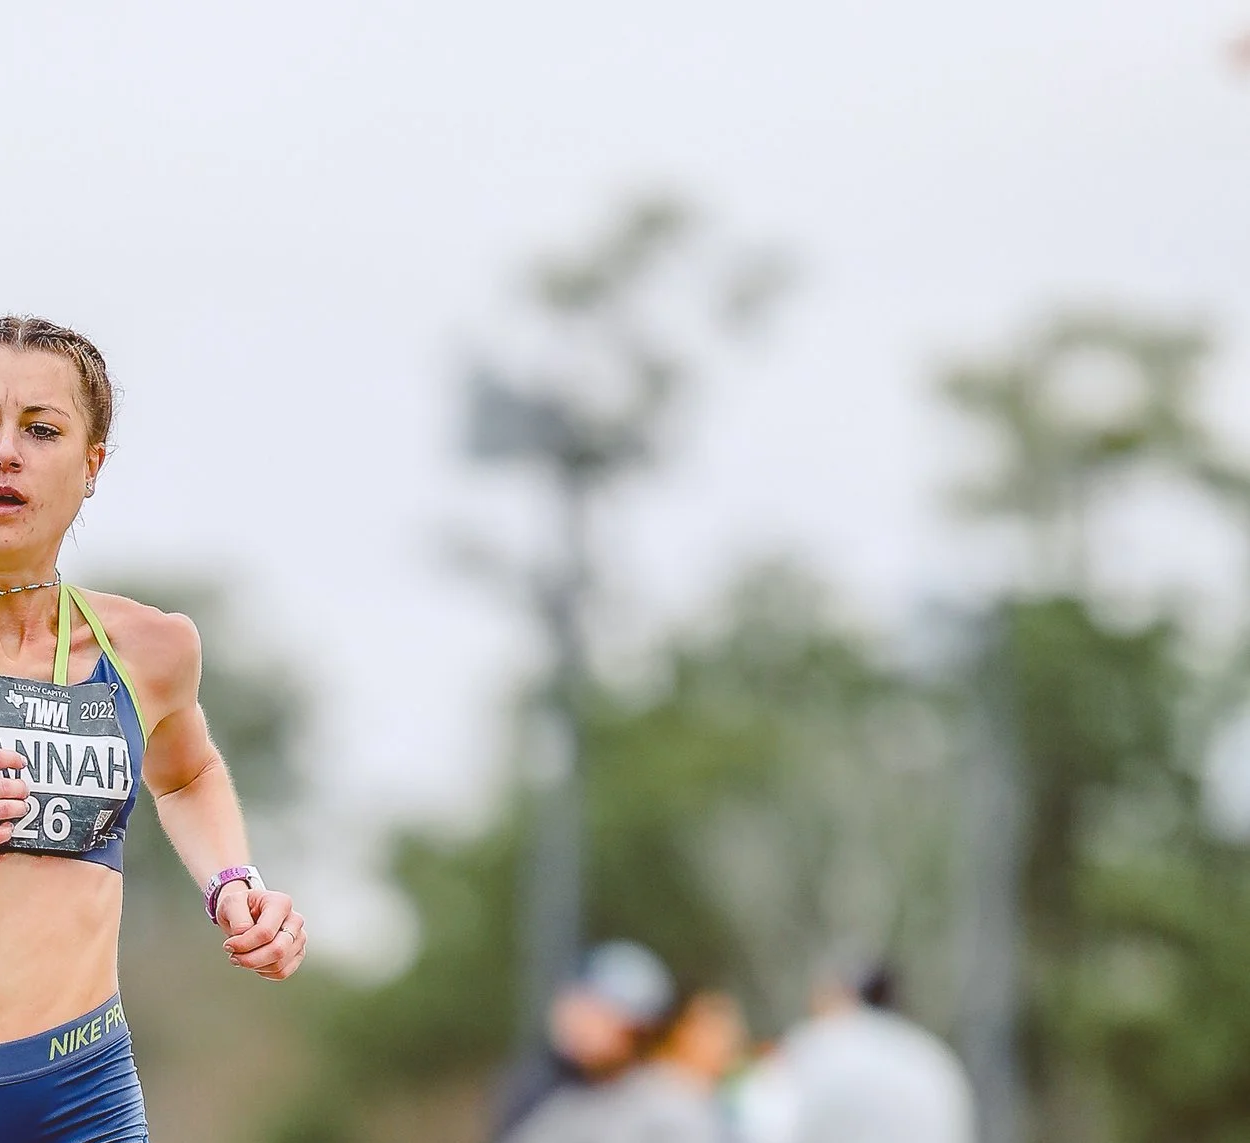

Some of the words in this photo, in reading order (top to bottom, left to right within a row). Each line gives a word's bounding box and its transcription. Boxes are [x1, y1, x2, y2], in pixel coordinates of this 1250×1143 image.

[13, 683, 41, 693] LEGACY
[42, 687, 71, 698] CAPITAL
[24, 696, 69, 728] TWM
[80, 701, 115, 720] 2022
[12, 795, 72, 841] 26
[49, 1016, 102, 1060] NIKE
[105, 1002, 125, 1033] PR
